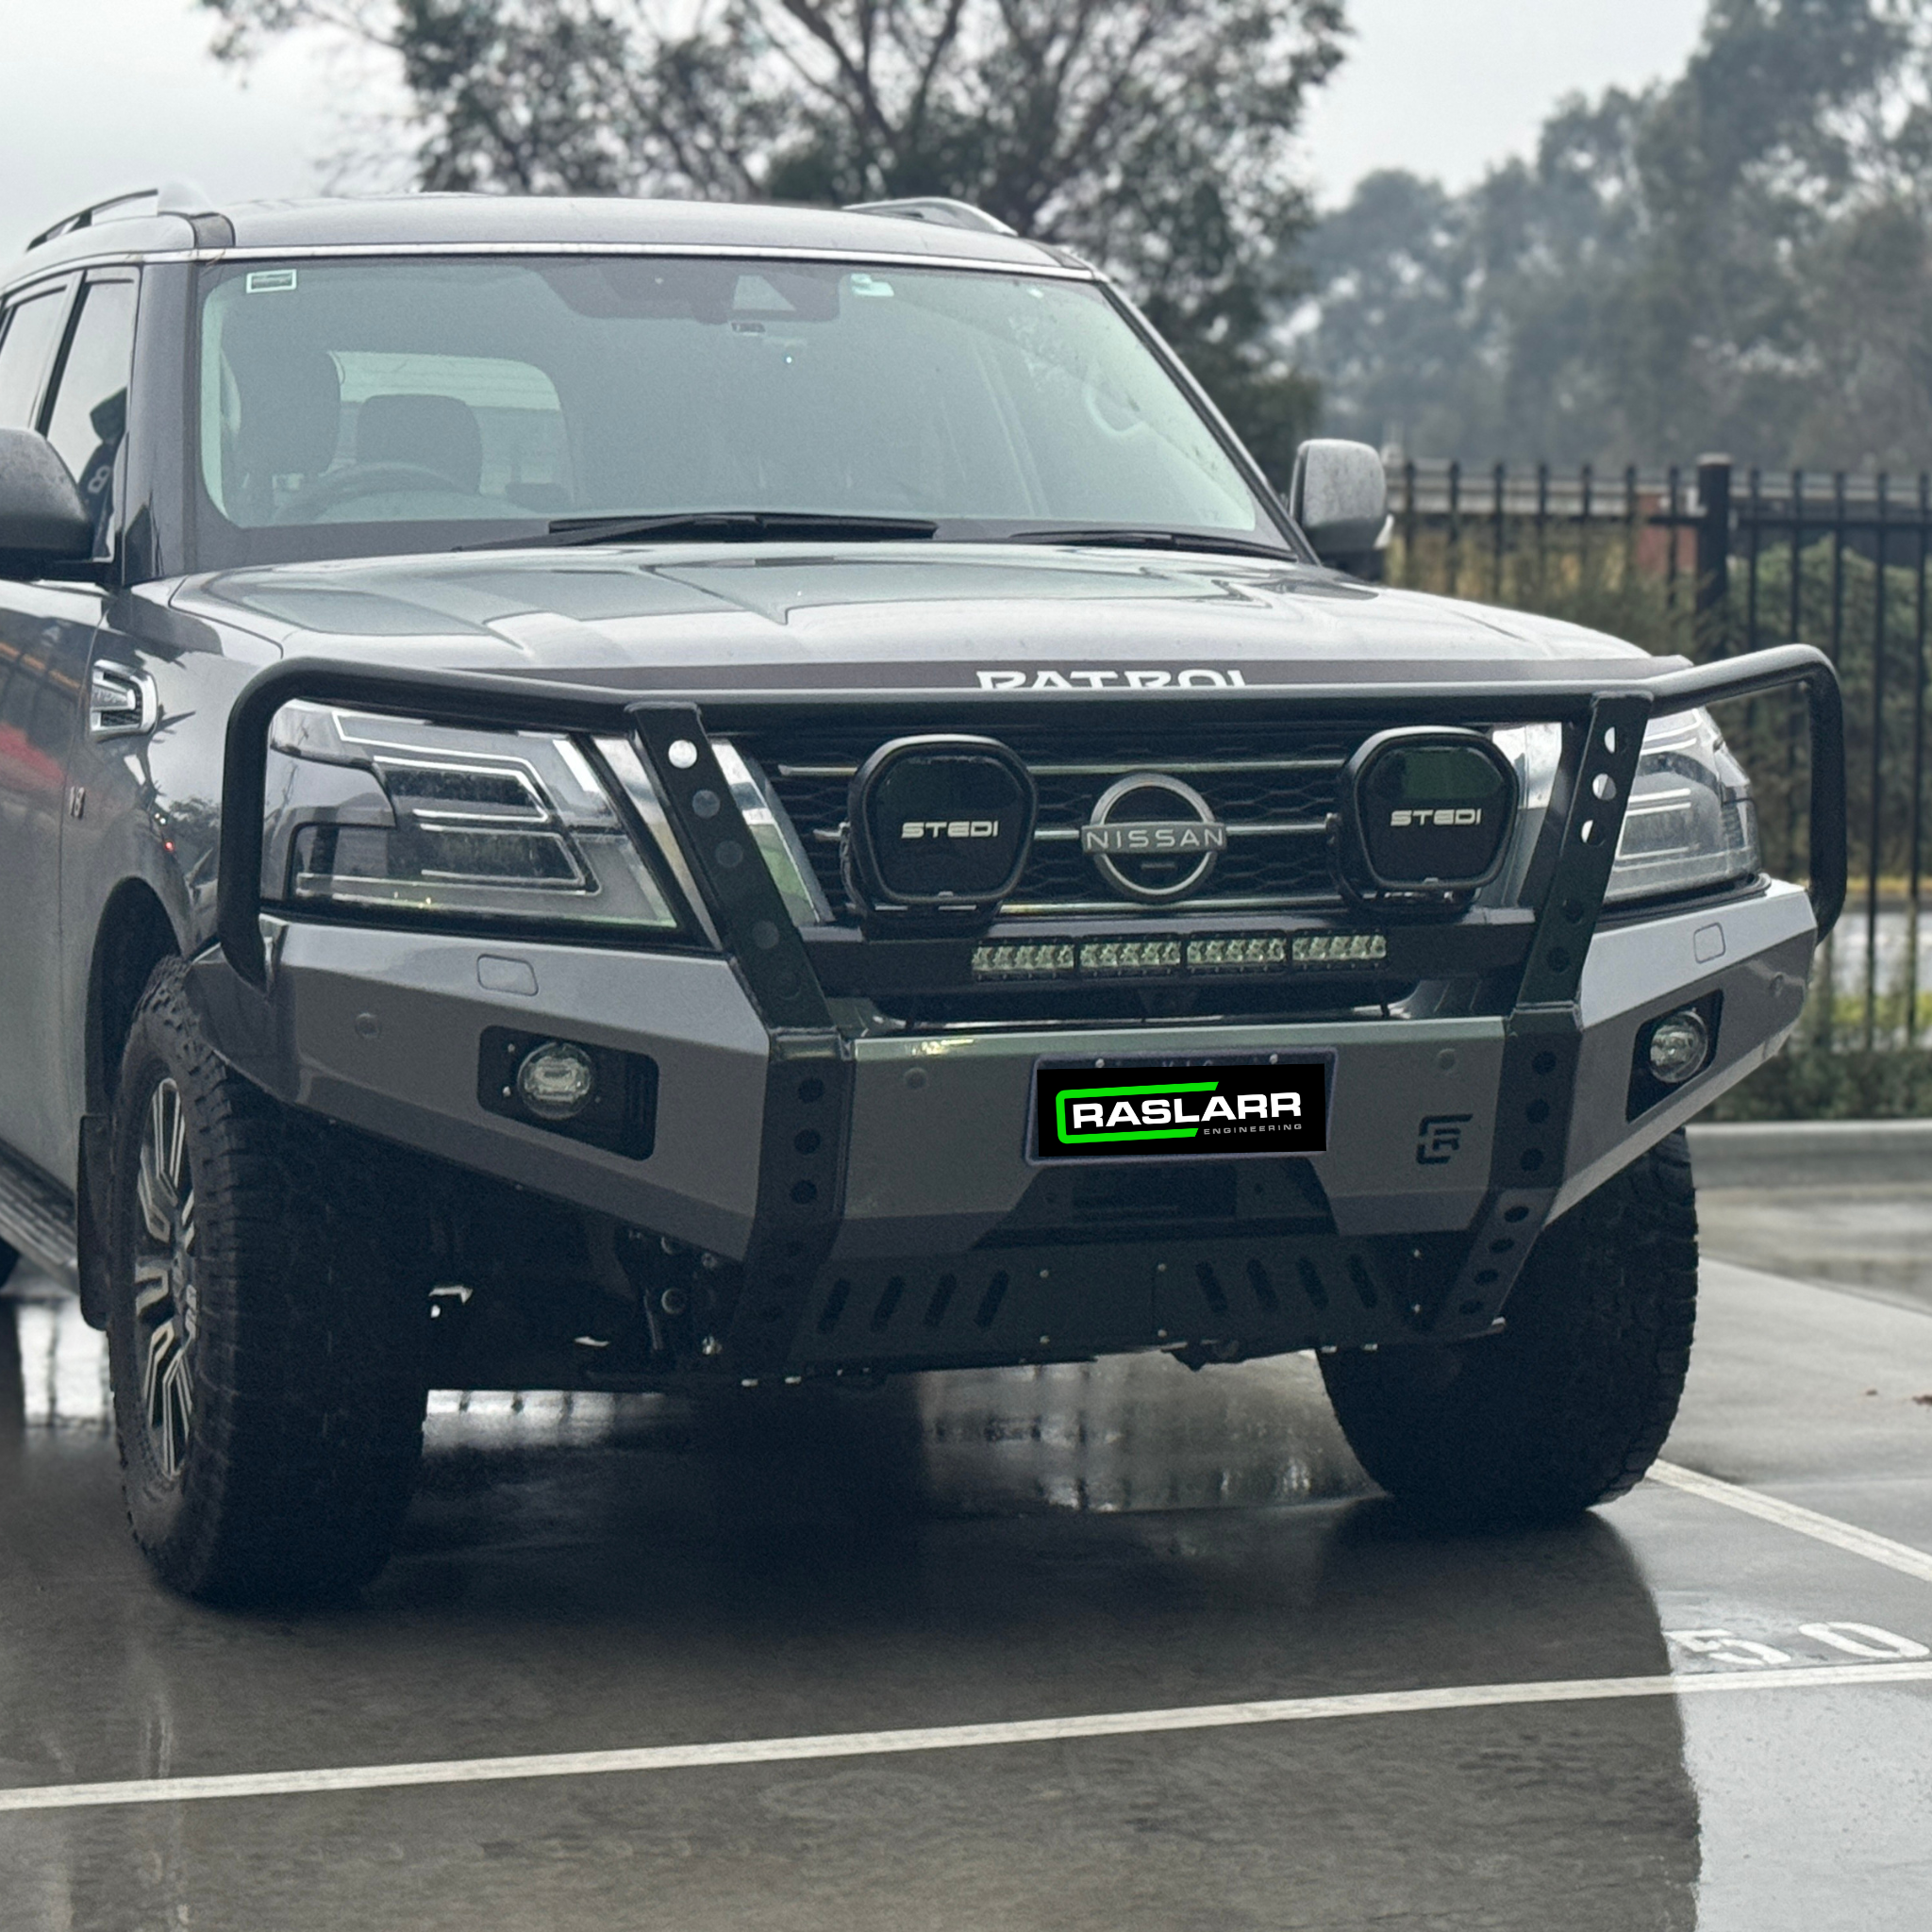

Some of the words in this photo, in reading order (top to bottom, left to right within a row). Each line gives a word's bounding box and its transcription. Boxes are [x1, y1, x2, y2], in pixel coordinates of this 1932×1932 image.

[1390, 808, 1482, 827] STEDI
[901, 820, 999, 839] STEDI
[1086, 828, 1223, 849] NISSAN
